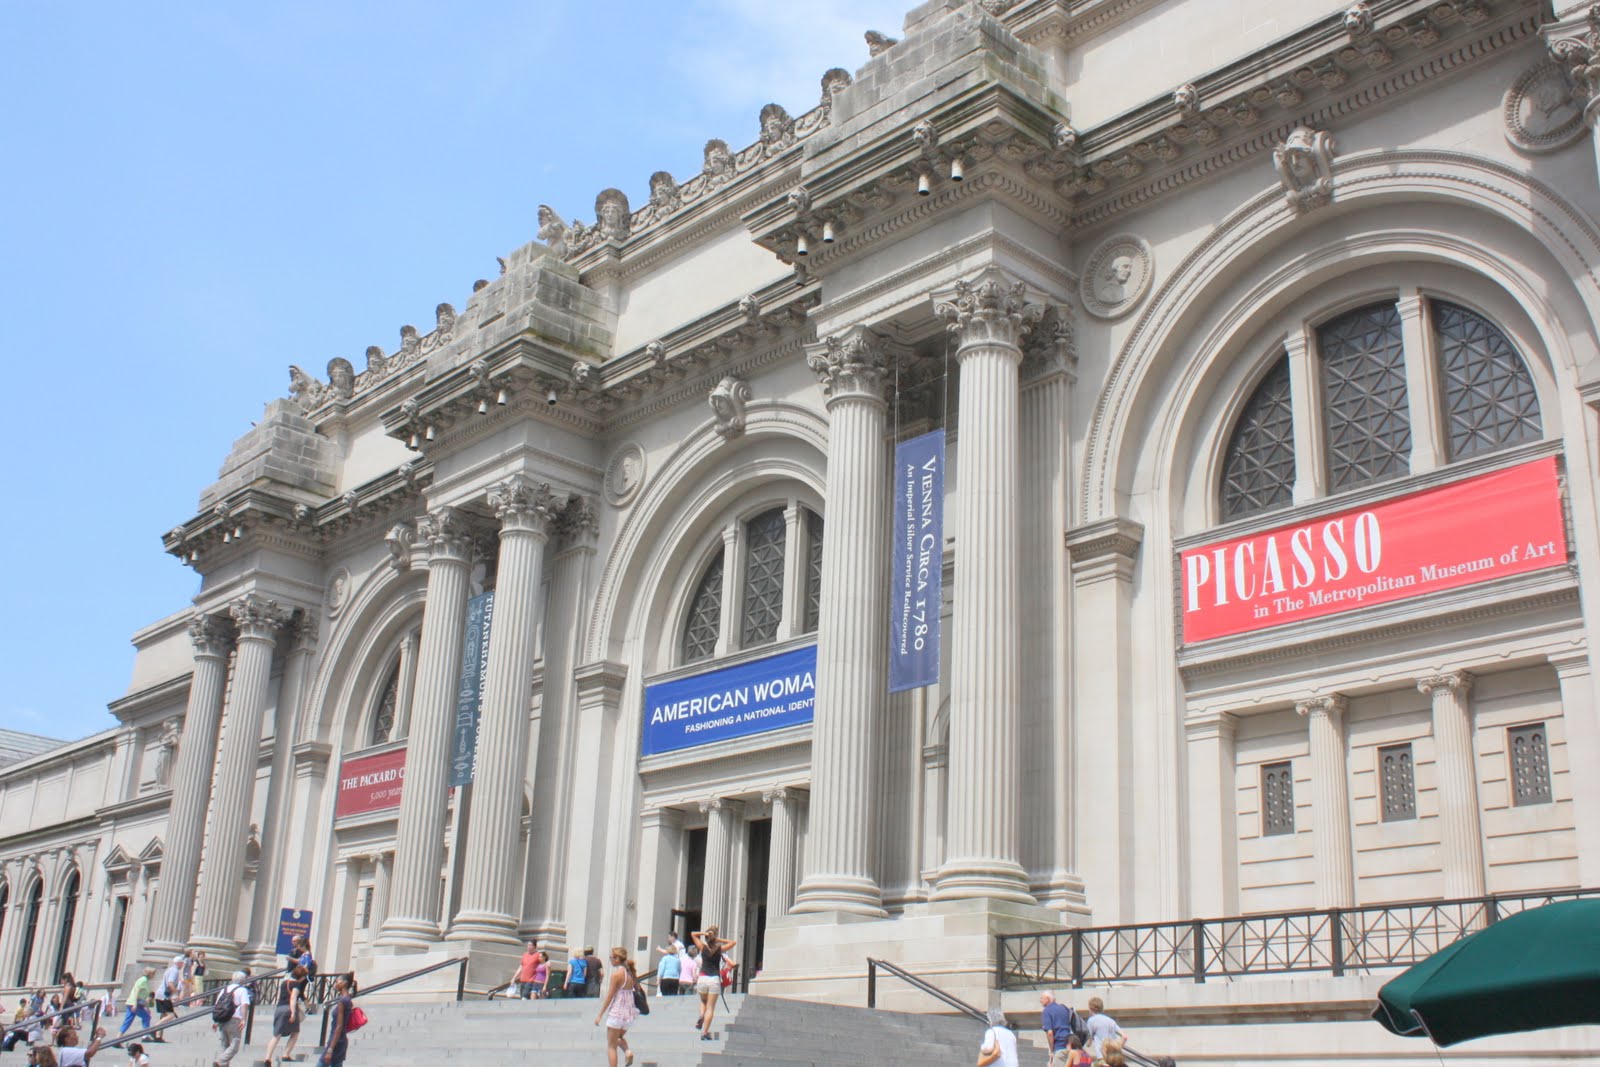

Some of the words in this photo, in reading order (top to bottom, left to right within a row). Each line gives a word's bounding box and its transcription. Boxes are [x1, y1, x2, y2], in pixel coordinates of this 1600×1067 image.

[907, 464, 915, 478] An
[921, 455, 936, 529] VIENNA
[906, 480, 915, 521] Imperial
[906, 524, 915, 552] Silver
[917, 533, 935, 592] CIRCA
[1186, 512, 1382, 612] PICASSO
[905, 554, 914, 588] Service
[1253, 603, 1269, 618] in
[1273, 596, 1304, 614] The
[1308, 566, 1416, 606] Metropolitan
[1420, 556, 1494, 583] Museum
[1499, 546, 1518, 565] of
[1524, 540, 1556, 560] Art
[901, 591, 912, 655] Rediscovered
[912, 598, 928, 650] 1780
[651, 688, 748, 725] AMERICAN
[754, 672, 815, 702] WOMA
[685, 716, 734, 733] FASHIONING
[736, 714, 742, 722] A
[744, 705, 786, 721] NATIONAL
[788, 698, 815, 712] IDENT
[342, 777, 358, 790] THE
[360, 769, 396, 787] PACKARD
